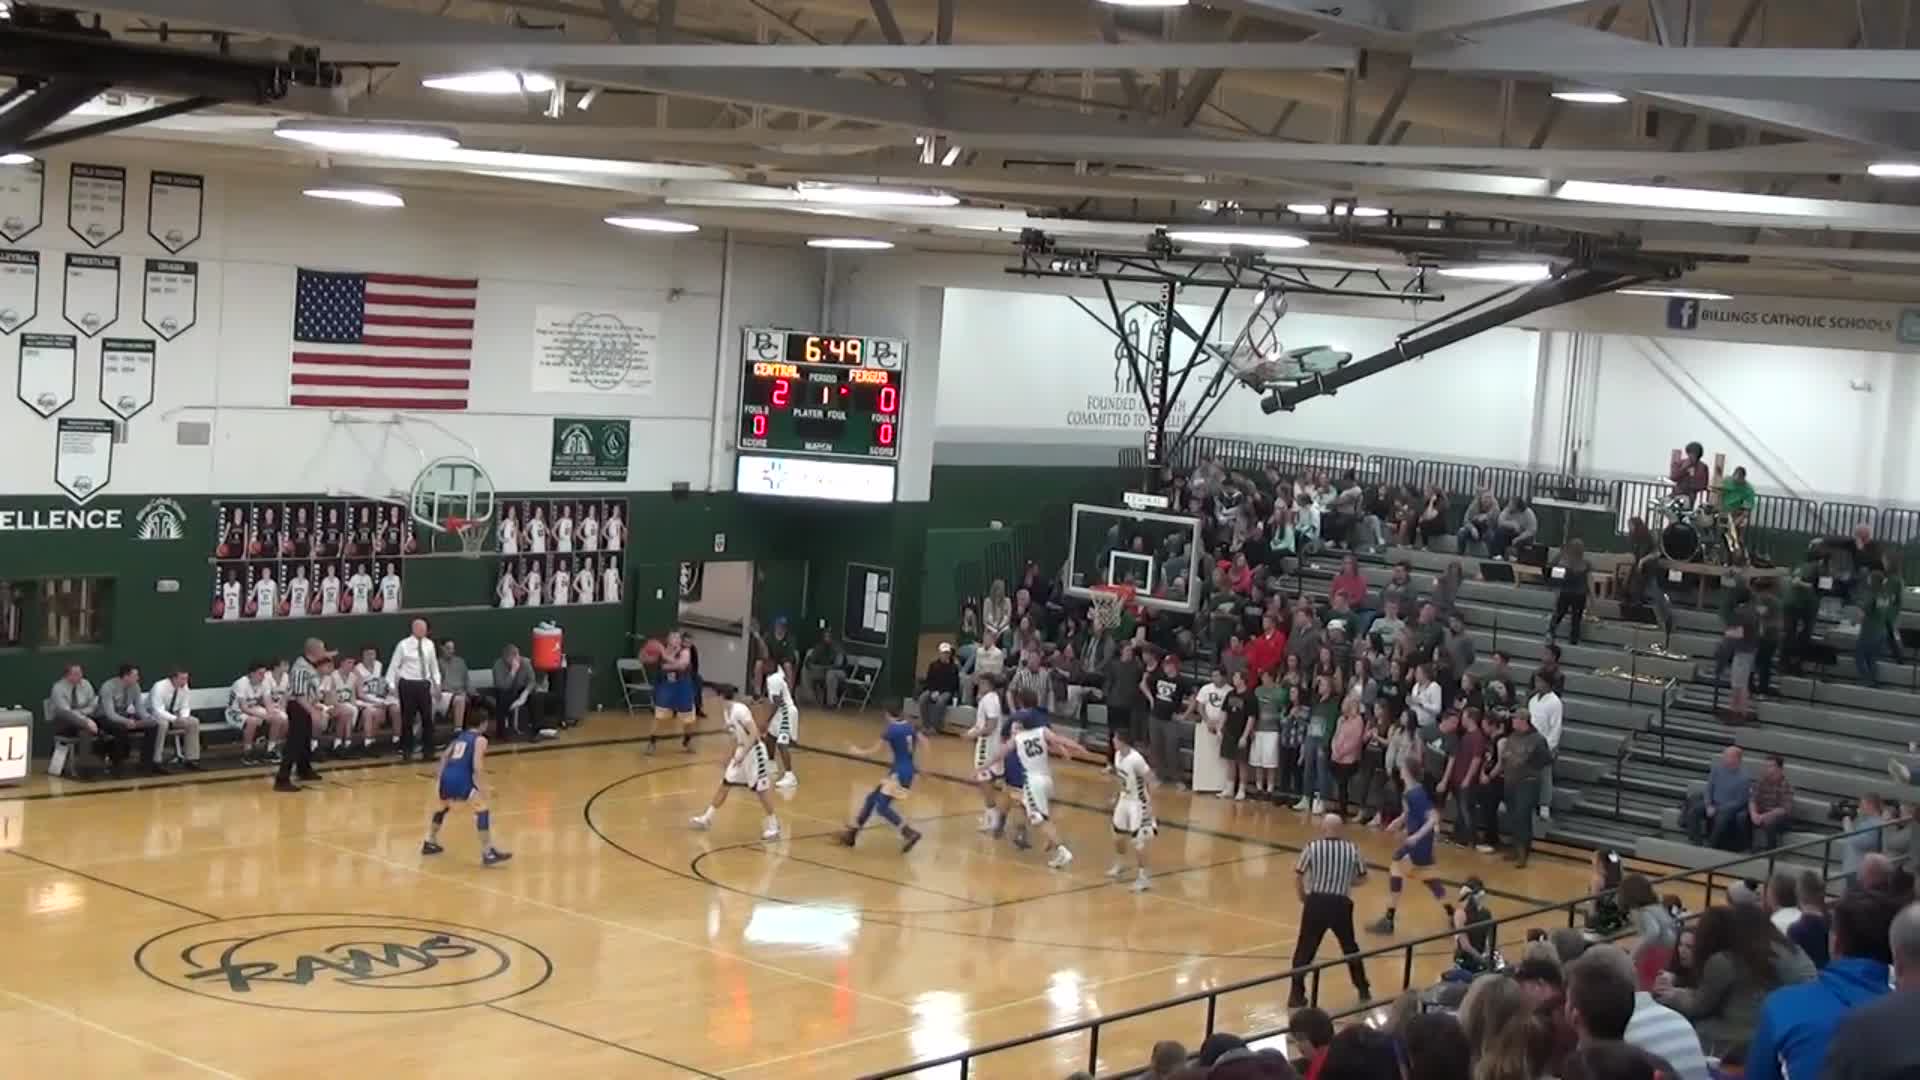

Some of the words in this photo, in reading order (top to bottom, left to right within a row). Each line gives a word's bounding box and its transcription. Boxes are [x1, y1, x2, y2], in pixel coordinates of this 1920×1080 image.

[1701, 309, 1759, 325] BILLINGS
[1761, 312, 1825, 329] CATHOLIC
[1828, 316, 1893, 332] SCHOOLS
[806, 336, 862, 364] 6:49
[754, 362, 800, 379] CENTRAL
[809, 373, 838, 383] PERIOD
[848, 369, 888, 384] FERGUS
[772, 379, 789, 405] 2
[880, 386, 896, 412] 0
[1087, 396, 1136, 411] FOUNDED
[793, 408, 823, 419] PLAYER
[827, 410, 846, 420] FOUL
[1066, 411, 1131, 426] COMMITTED
[1133, 412, 1147, 426] TO
[753, 415, 766, 435] 0
[879, 424, 892, 444] 0
[0, 509, 123, 530] ELLENCE
[1024, 737, 1044, 758] 25
[185, 935, 476, 992] RAMS
